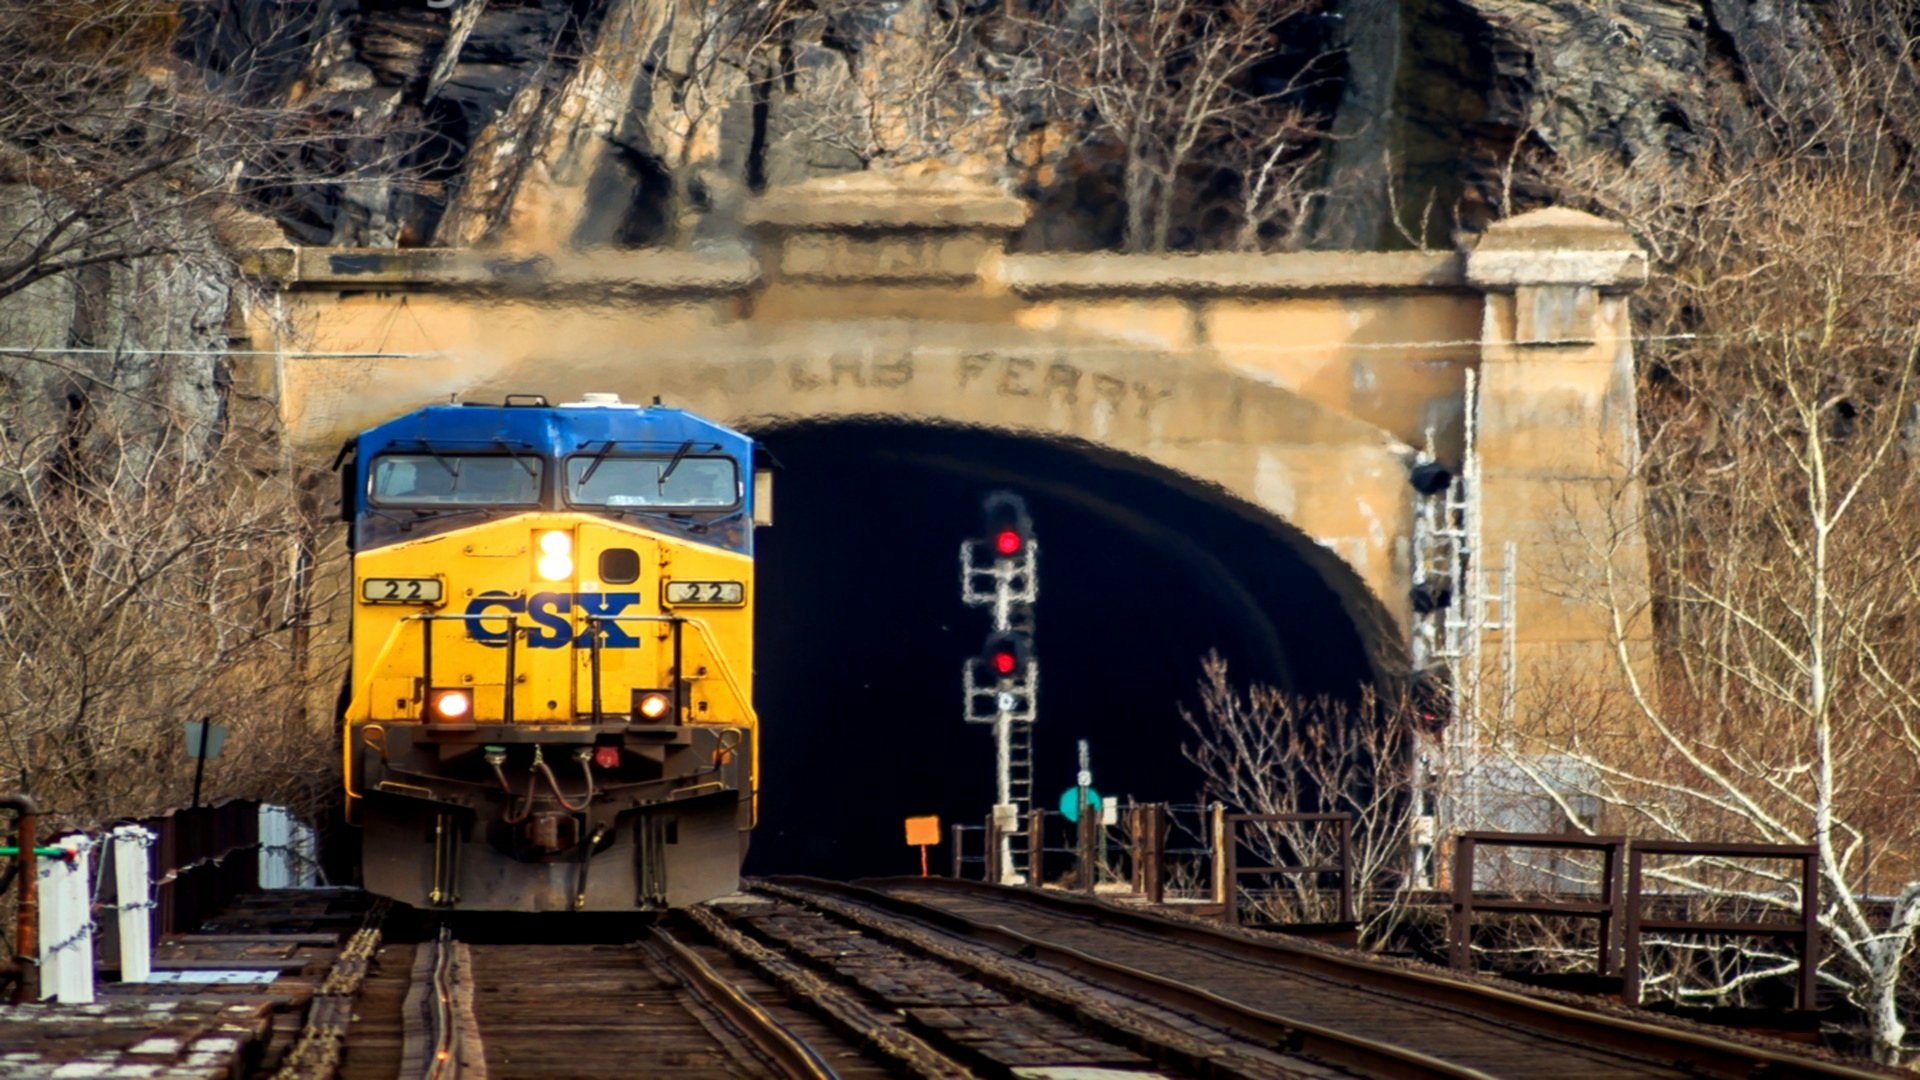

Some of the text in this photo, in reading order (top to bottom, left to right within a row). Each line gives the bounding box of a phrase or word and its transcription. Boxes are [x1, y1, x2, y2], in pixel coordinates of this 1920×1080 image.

[384, 580, 421, 599] 22
[686, 582, 722, 601] 22
[465, 590, 640, 649] CSX
